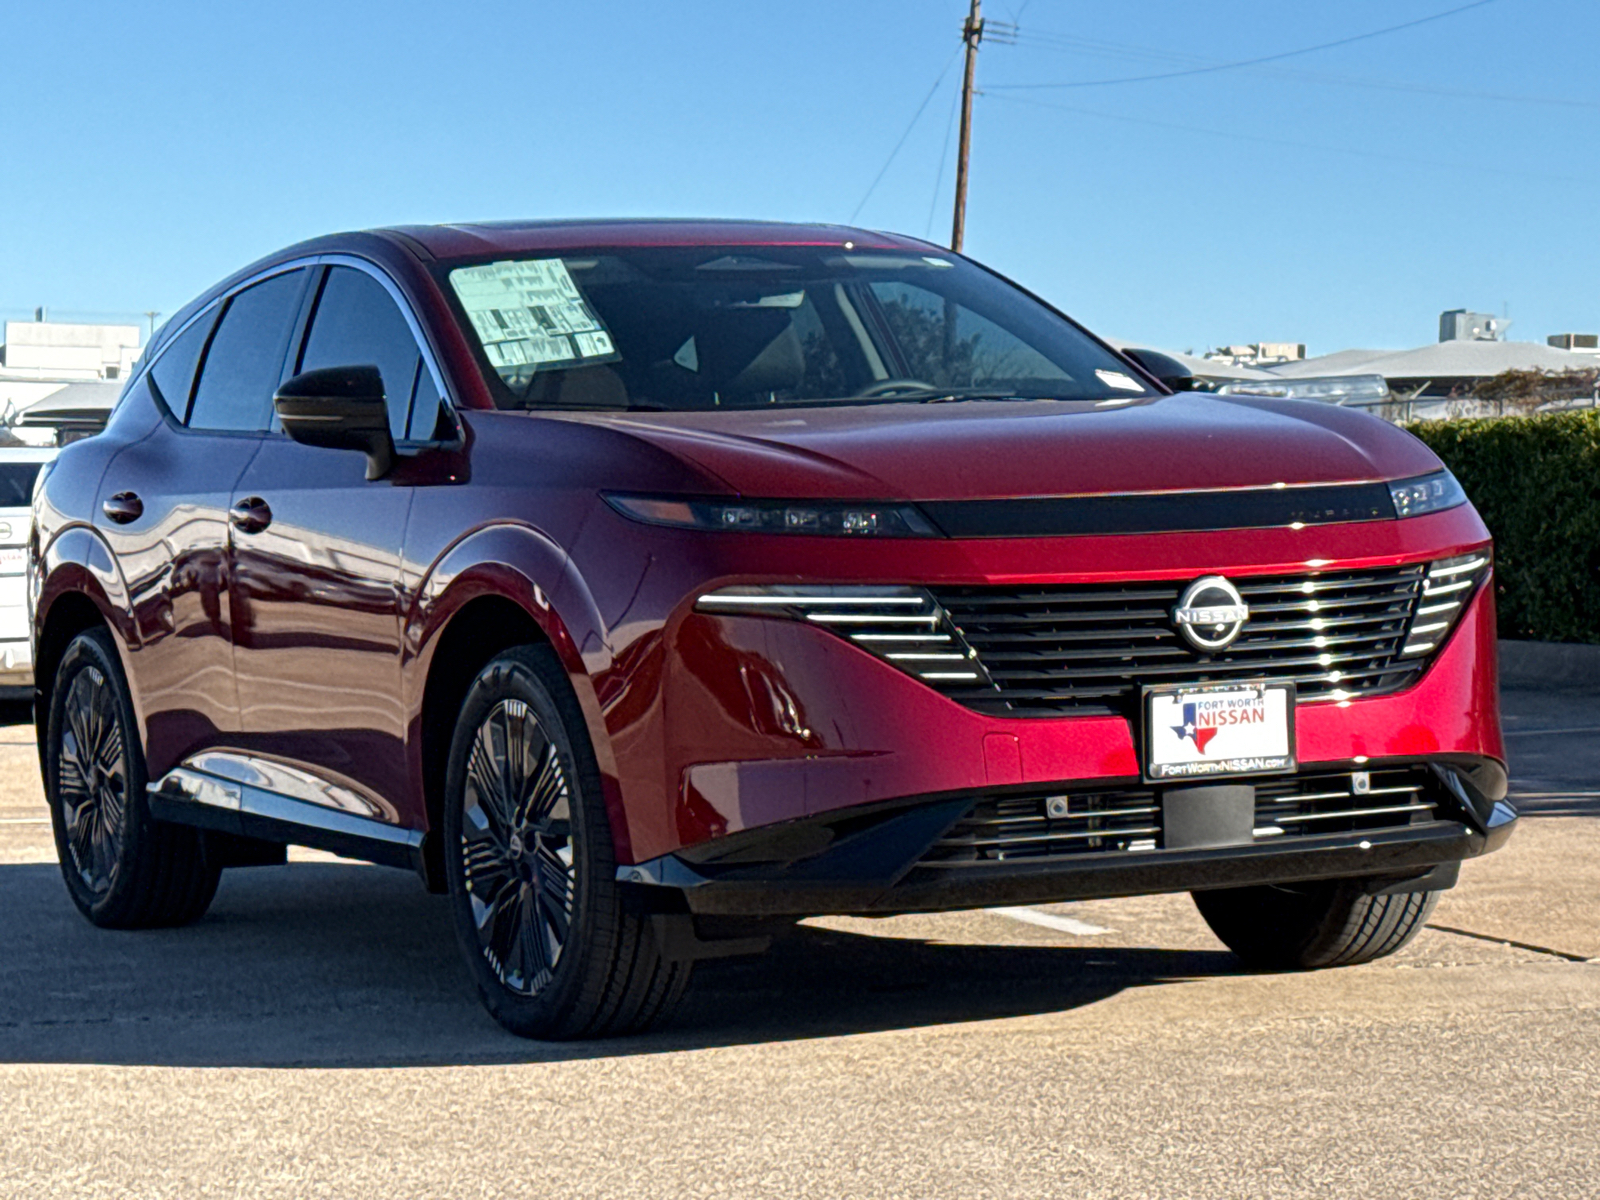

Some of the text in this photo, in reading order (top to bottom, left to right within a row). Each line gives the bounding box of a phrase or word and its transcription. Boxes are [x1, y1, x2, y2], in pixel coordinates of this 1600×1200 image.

[1176, 607, 1247, 622] NISSAN
[1198, 698, 1264, 710] FORT WORTH
[1199, 707, 1265, 726] NISSAN
